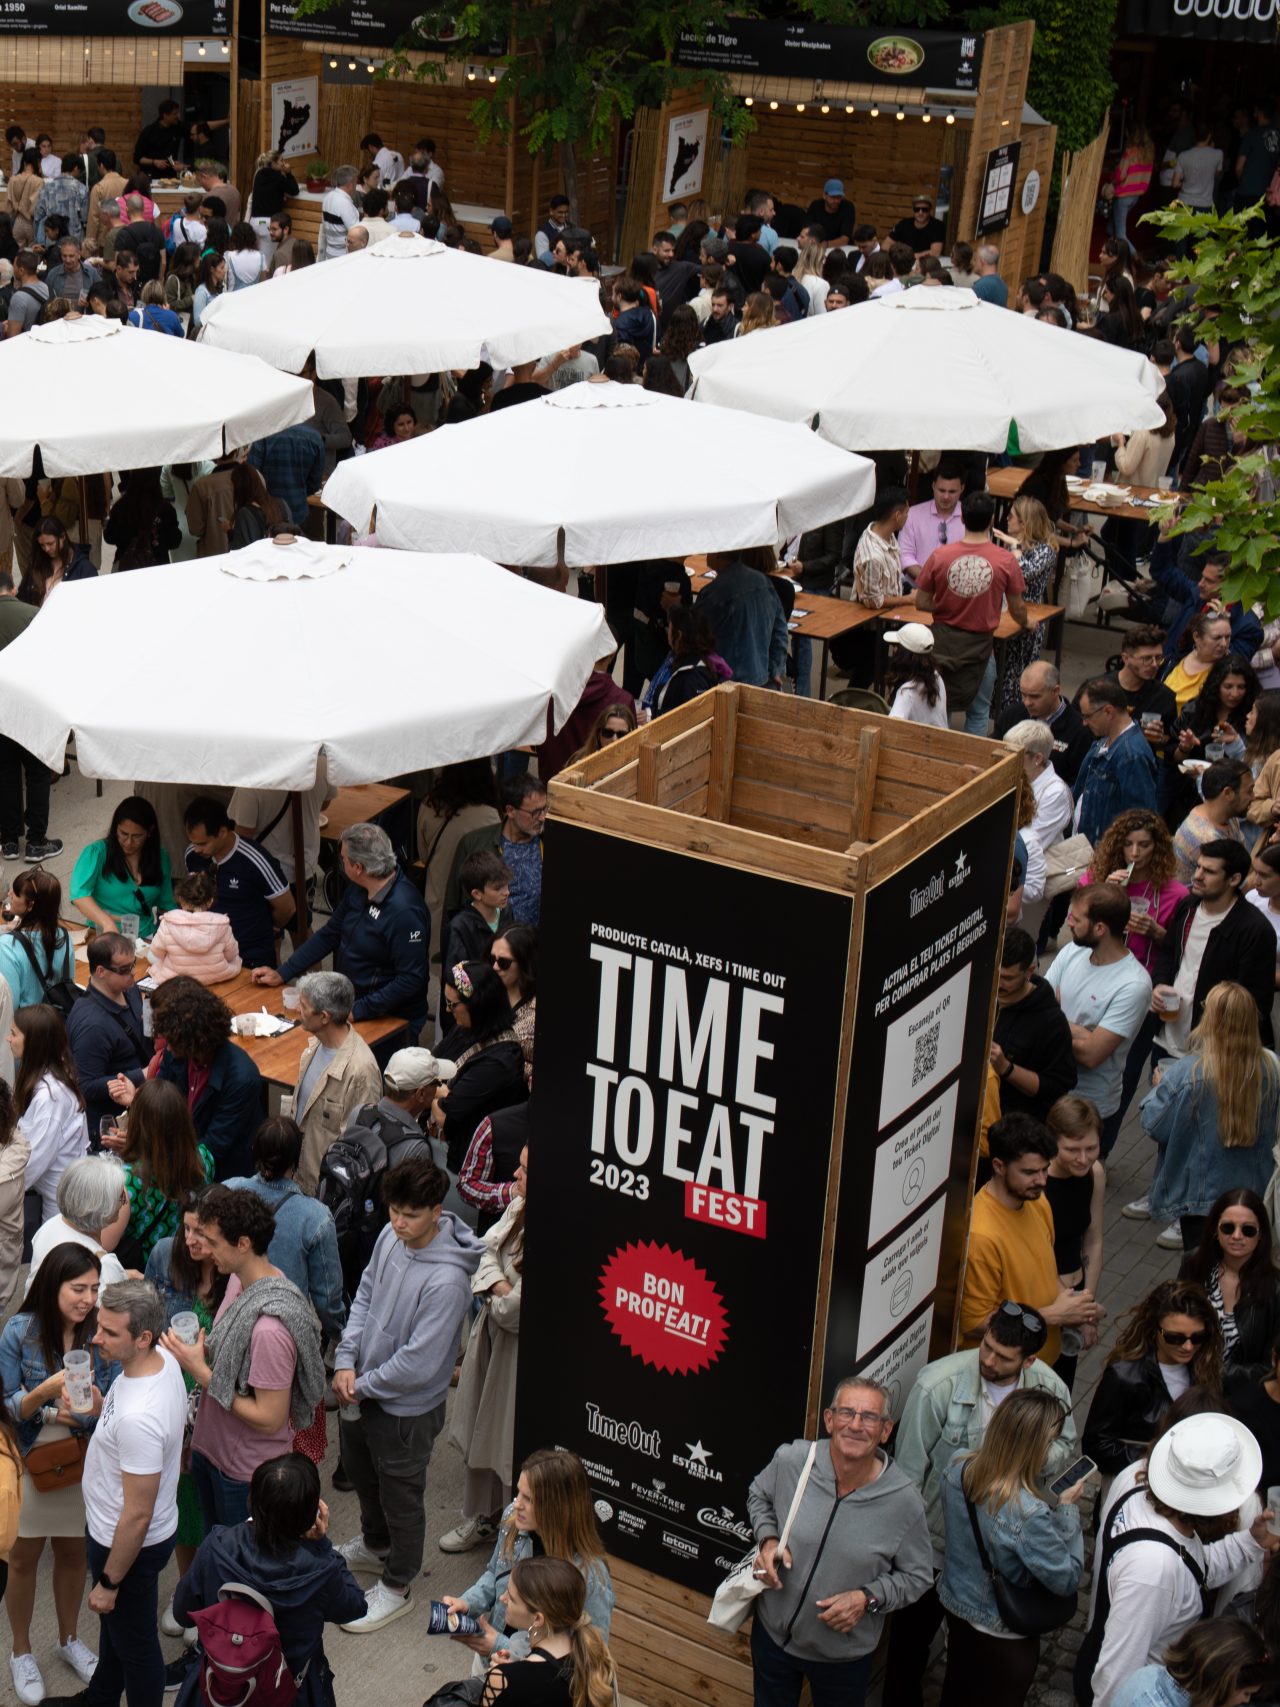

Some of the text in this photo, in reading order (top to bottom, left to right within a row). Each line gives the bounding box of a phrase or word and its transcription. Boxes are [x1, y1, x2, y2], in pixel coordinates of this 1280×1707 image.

[4, 3, 25, 12] 1950
[270, 2, 281, 13] Per
[706, 34, 716, 44] de
[718, 34, 738, 47] Tigre
[590, 922, 786, 989] PRODUCTE CATALÀ, XEFS I TIME OUT
[874, 997, 891, 1019] PER
[891, 969, 928, 1003] COMPRAR
[930, 952, 951, 978] PLATS
[956, 920, 988, 956] BEGUDES
[882, 906, 984, 994] ACTIVA EL TEU TICKET DIGITAL
[590, 942, 785, 1114] TIME
[908, 1005, 934, 1038] Escaneja
[942, 994, 952, 1012] QR
[586, 1062, 775, 1201] TO EAT
[892, 1122, 941, 1172] teu Ticket Digital
[894, 1135, 909, 1154] Crea
[590, 1159, 650, 1202] 2023
[692, 1186, 759, 1230] FEST
[911, 1226, 923, 1246] amb
[880, 1235, 929, 1287] saldo que vulguis
[643, 1271, 685, 1306] BON
[615, 1286, 711, 1340] PROFEAT!
[581, 1458, 614, 1477] neralitat
[672, 1453, 723, 1482] ESTRELLA
[631, 1482, 686, 1512] FEVER-TREE
[696, 1507, 753, 1542] Cacaolat
